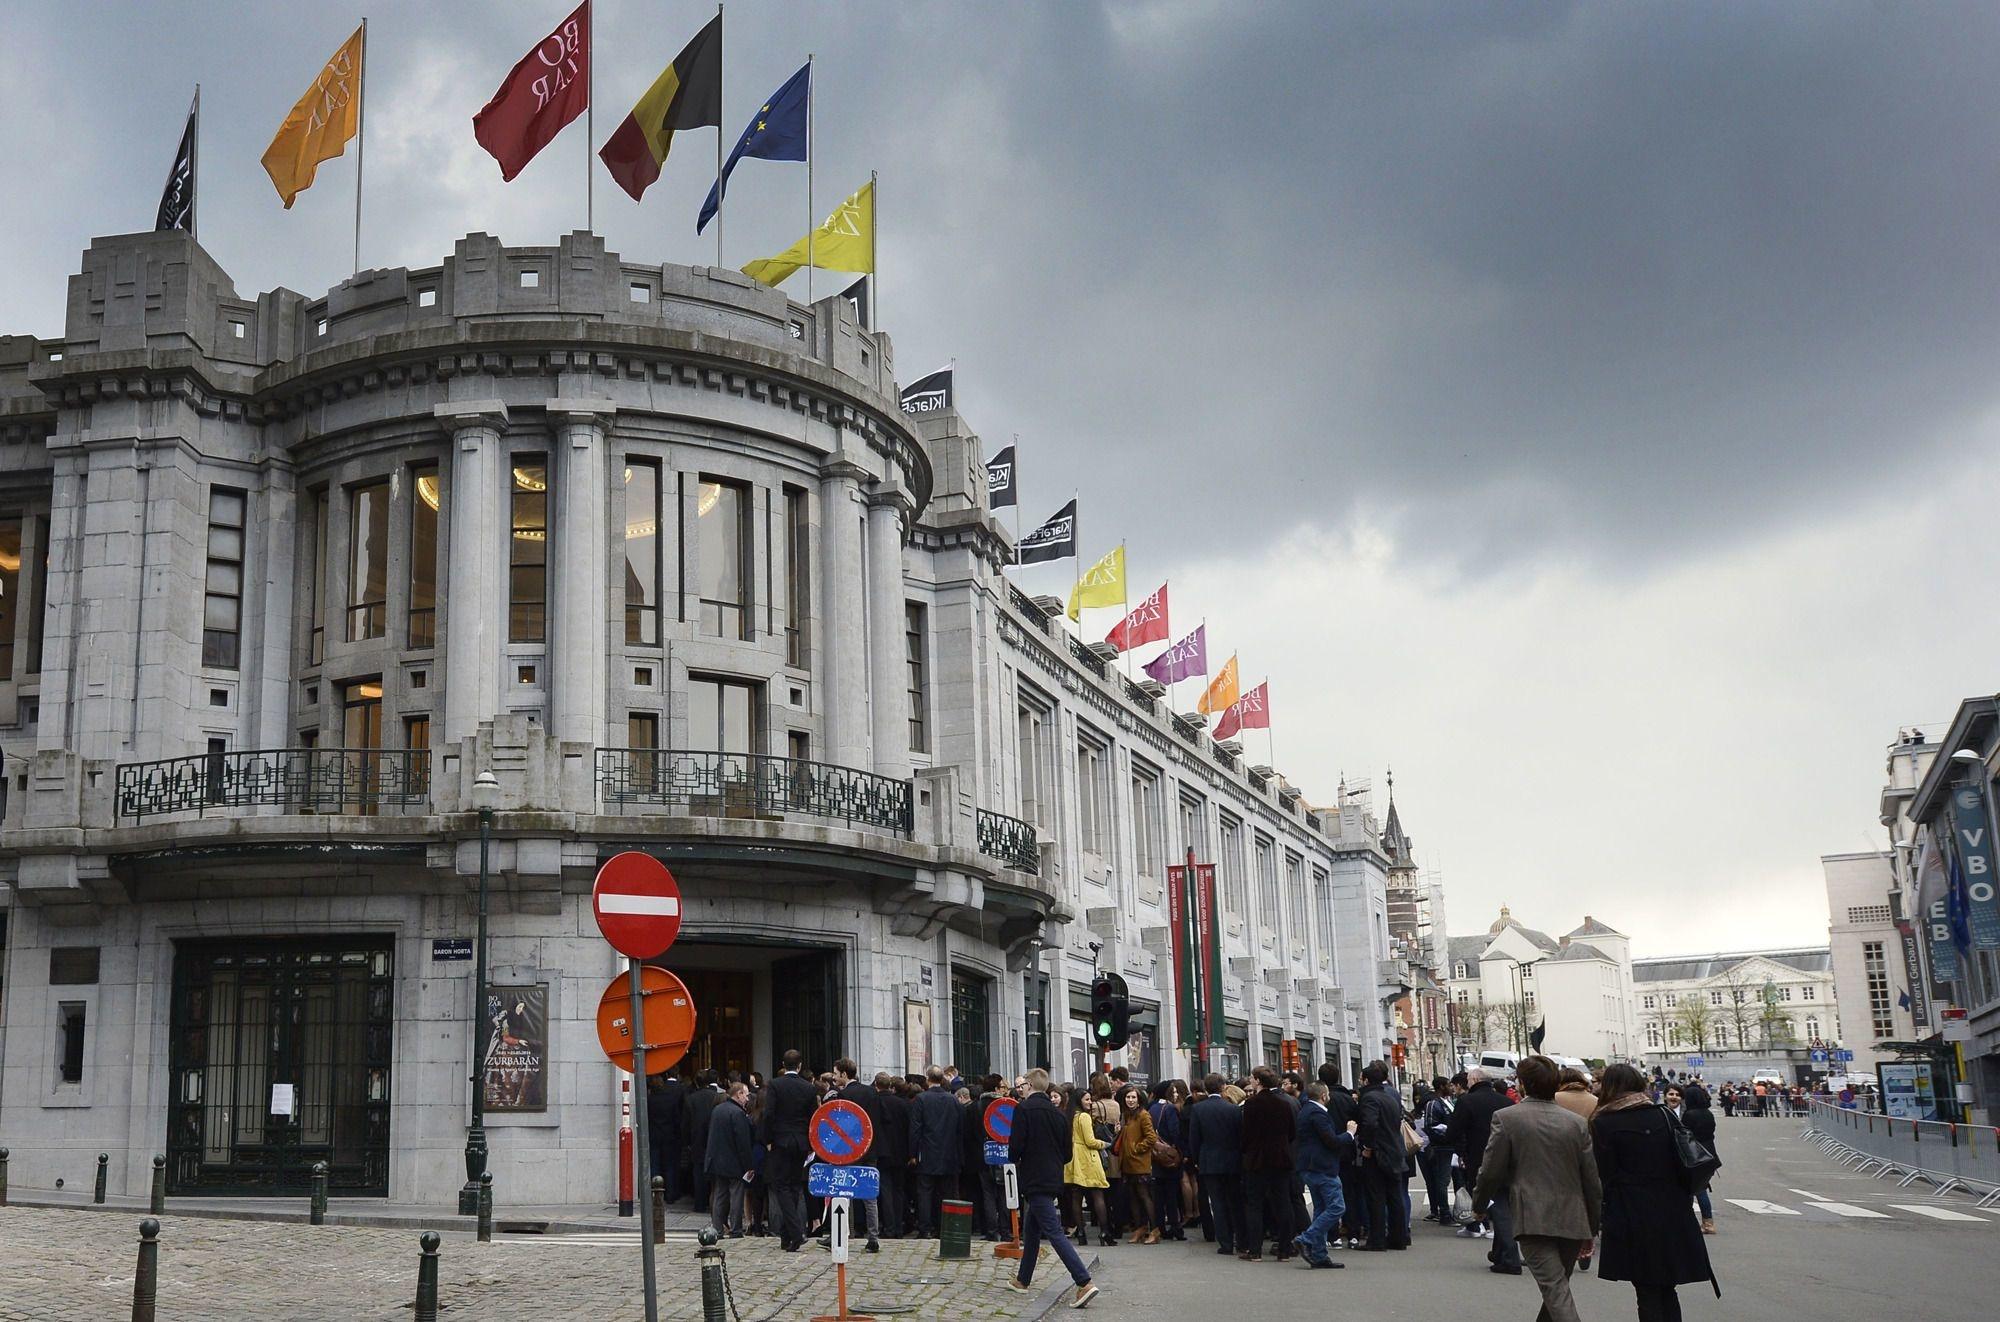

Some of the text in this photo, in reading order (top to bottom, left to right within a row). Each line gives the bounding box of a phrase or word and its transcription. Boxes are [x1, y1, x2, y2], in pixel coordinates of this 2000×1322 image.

[1962, 828, 1994, 902] VBO
[1904, 937, 1925, 1020] Laurent Gerbaud
[487, 1055, 539, 1066] ZURBARÁN
